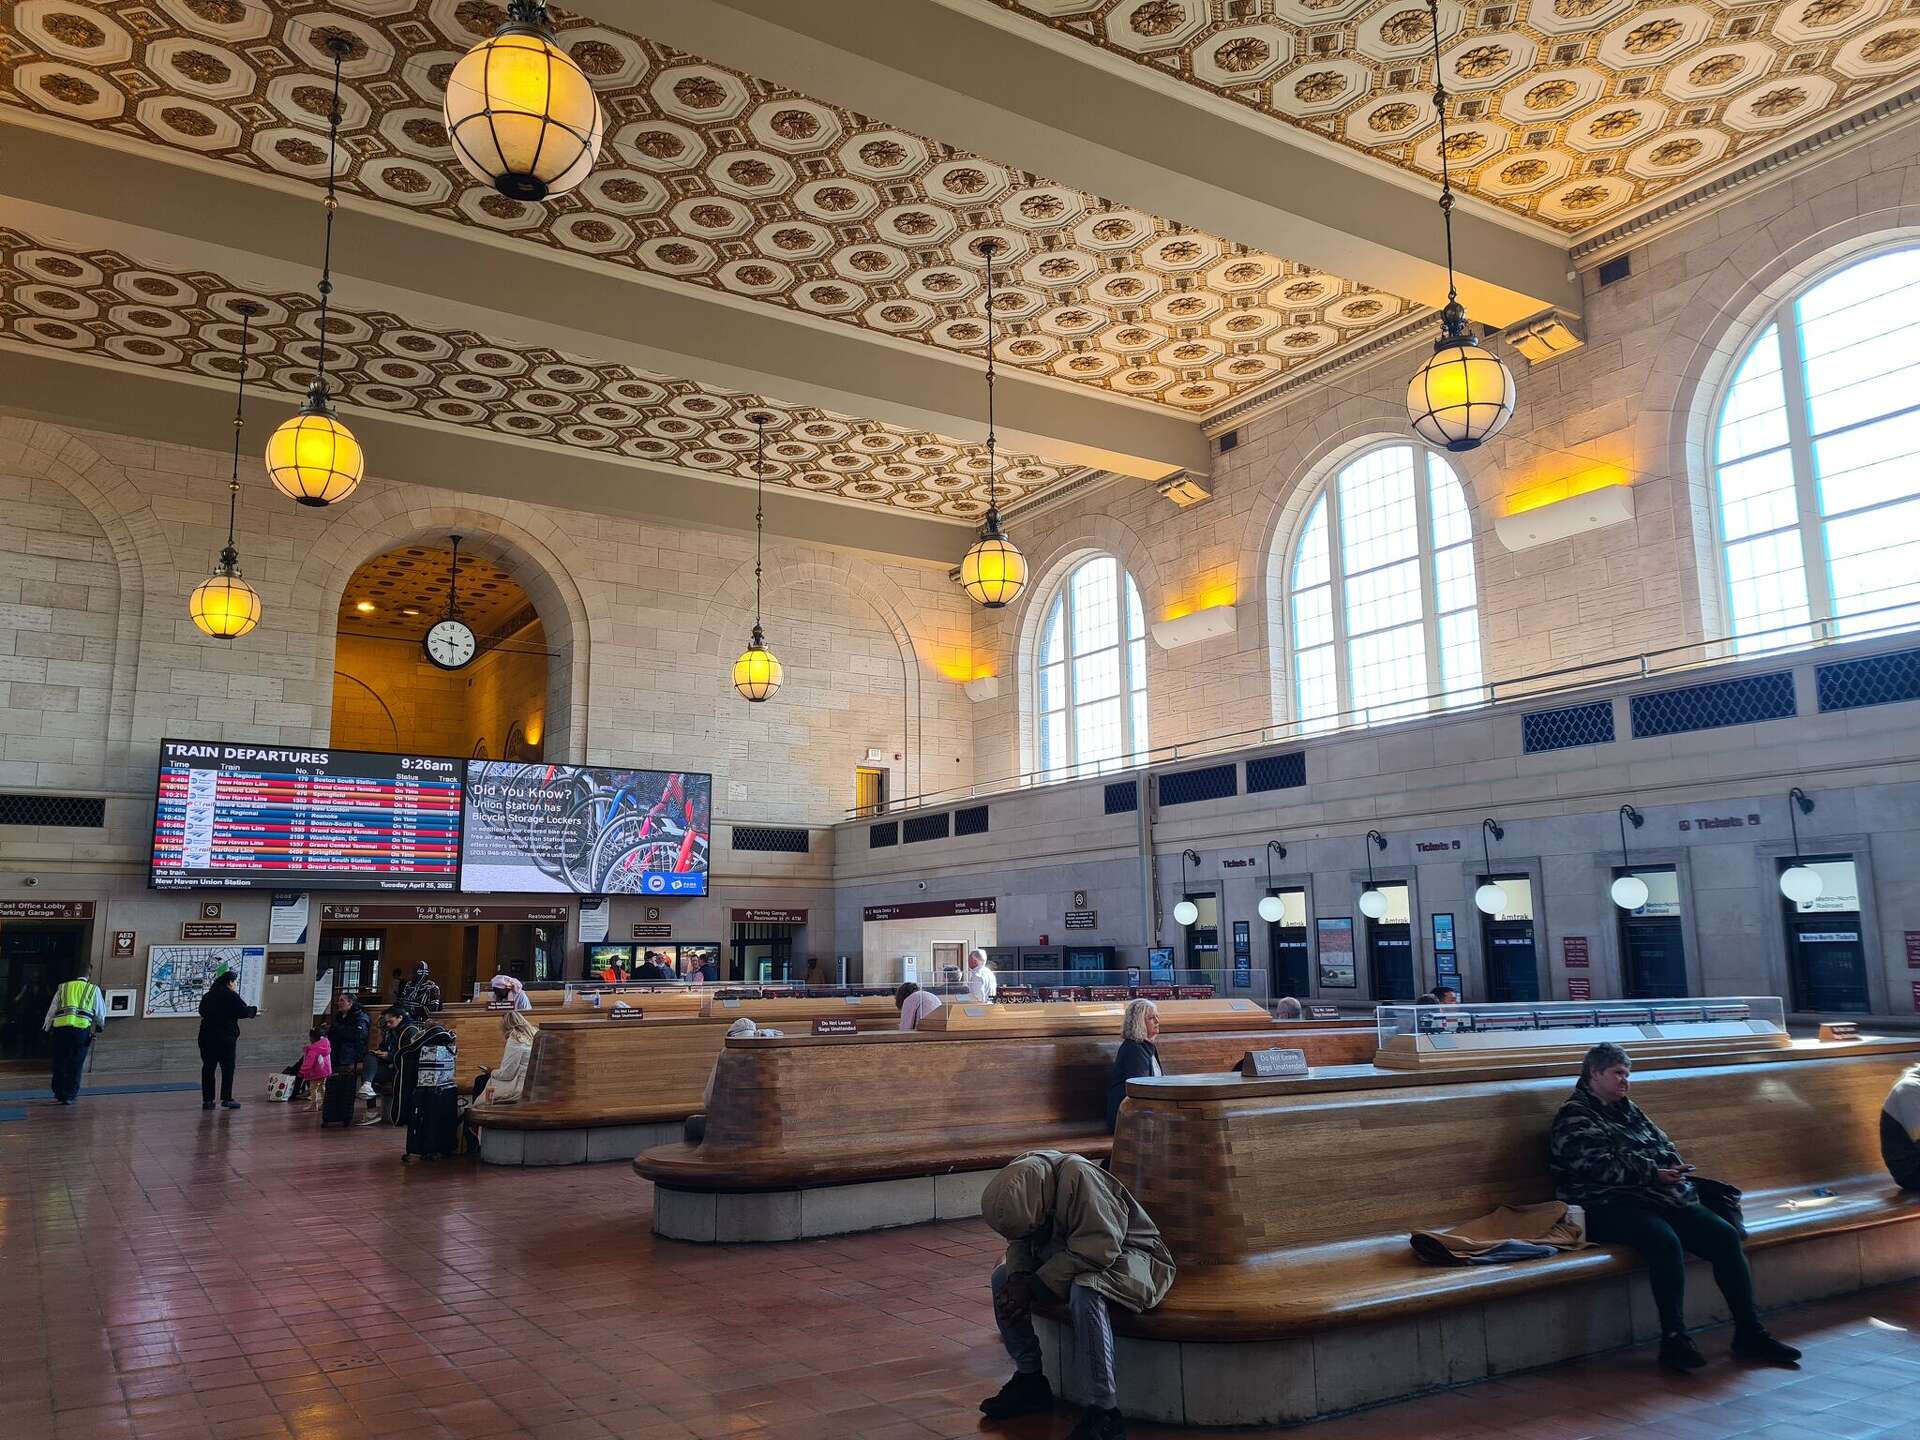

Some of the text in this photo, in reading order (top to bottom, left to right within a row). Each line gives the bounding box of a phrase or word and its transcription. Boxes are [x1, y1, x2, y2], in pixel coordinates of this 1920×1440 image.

[166, 744, 328, 764] TRAIN DEPARTURES
[402, 759, 453, 771] 9:26am
[474, 785, 572, 799] Did You Know?
[473, 800, 561, 811] Union Station has
[472, 813, 581, 825] Bicycle Storage Lockers
[1695, 817, 1743, 830] Tickets
[1416, 843, 1449, 852] Tickets
[1273, 1063, 1306, 1071] Unattended
